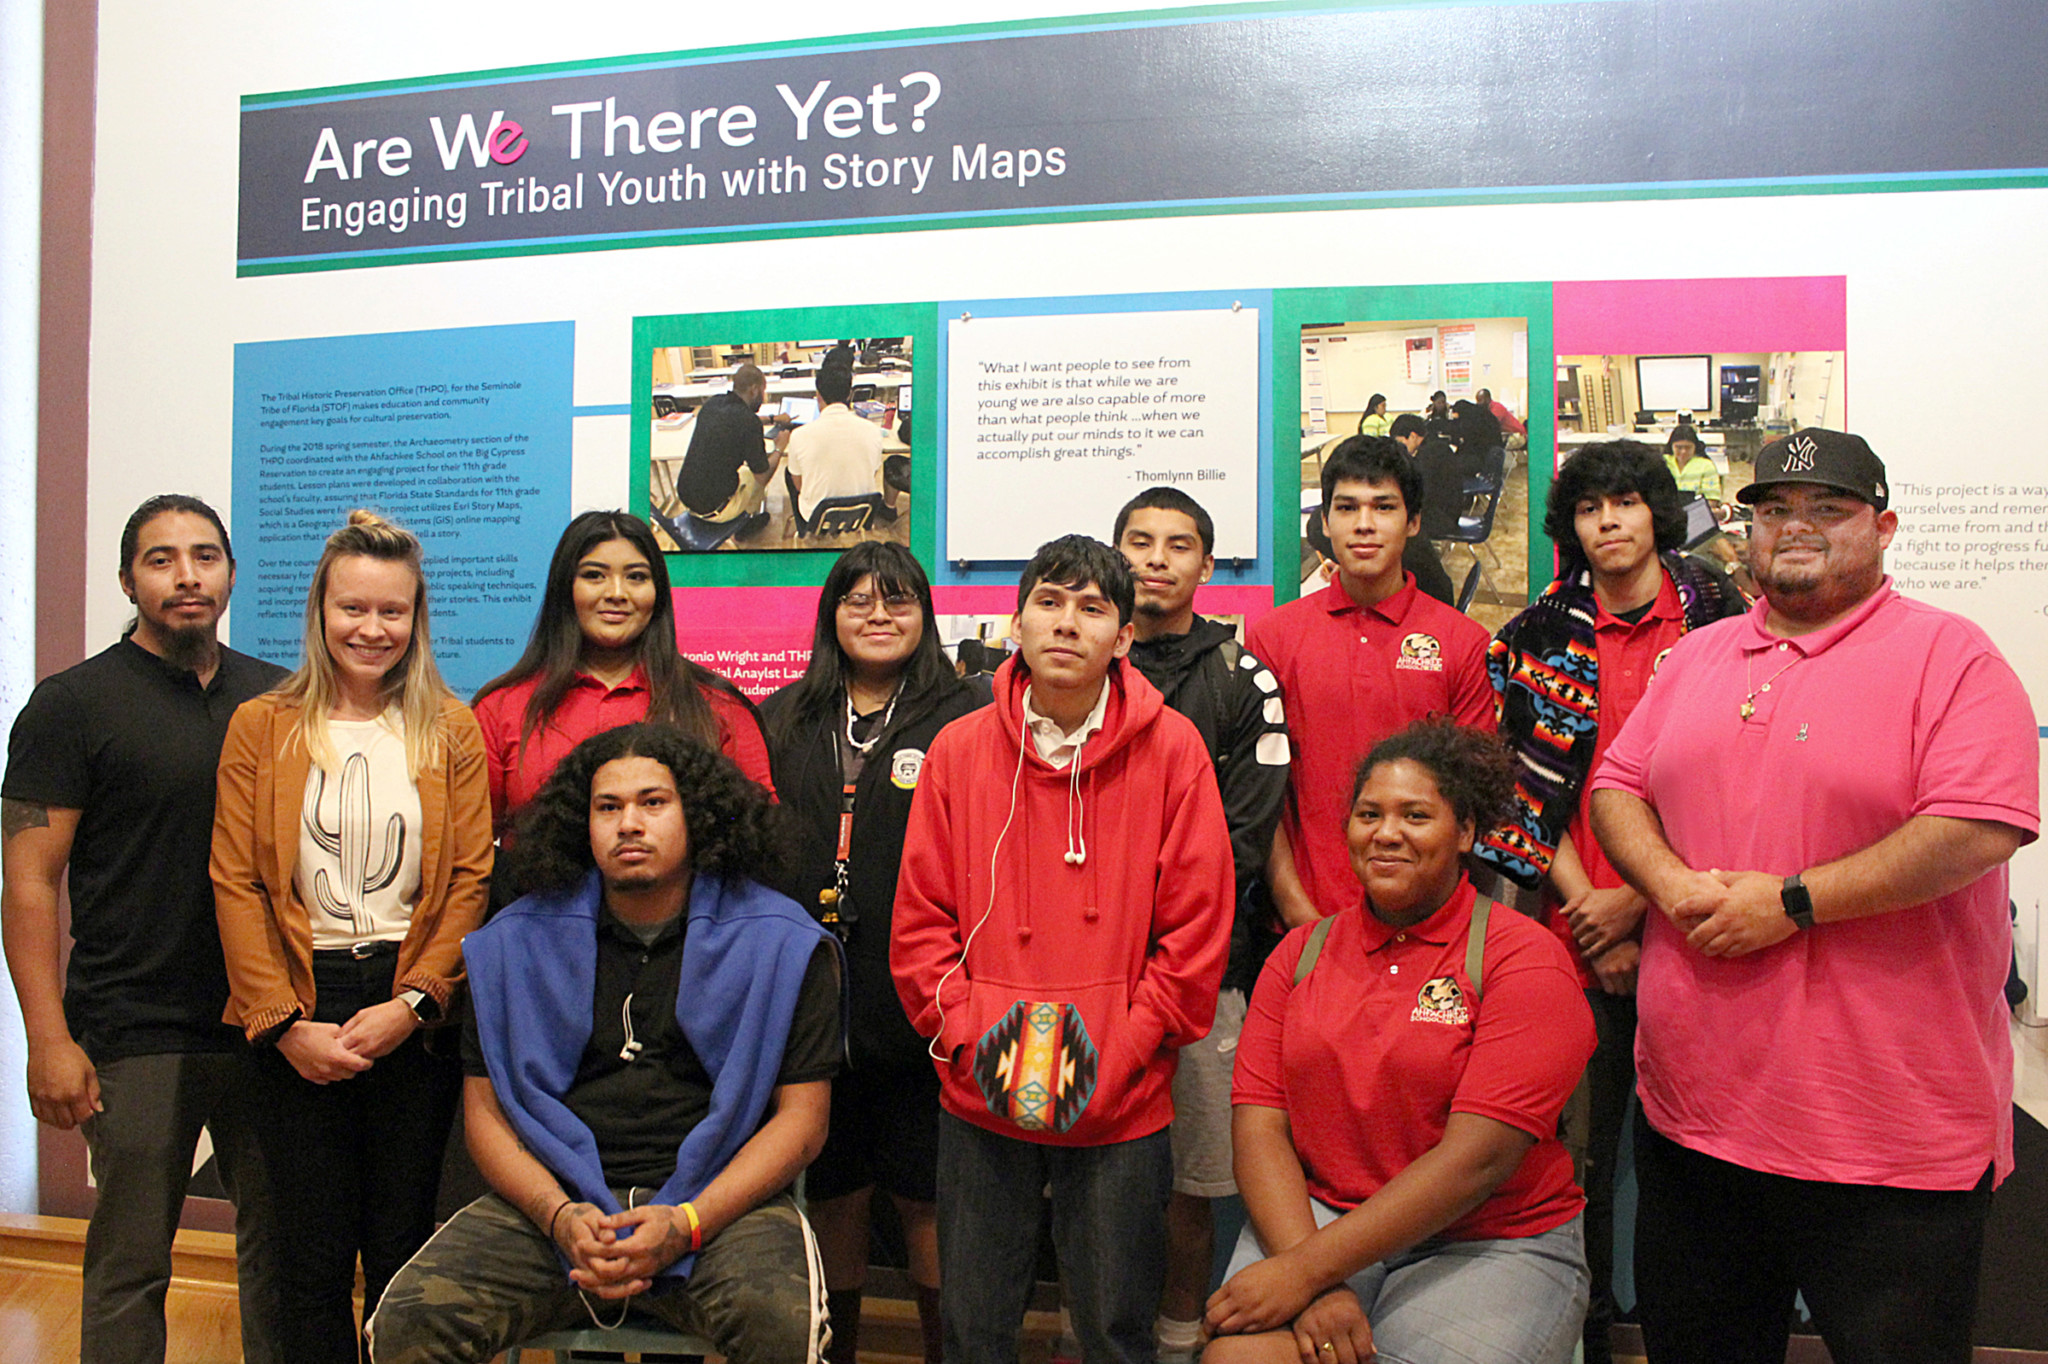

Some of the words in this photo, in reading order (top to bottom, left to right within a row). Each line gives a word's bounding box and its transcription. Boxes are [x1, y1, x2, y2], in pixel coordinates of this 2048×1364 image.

[304, 127, 412, 183] Are
[430, 110, 529, 164] We
[551, 96, 758, 158] There
[775, 70, 942, 140] Yet?
[301, 187, 468, 236] Engaging
[480, 173, 583, 216] Tribal
[598, 163, 707, 206] Youth
[722, 155, 806, 197] with
[822, 152, 934, 194] Story
[950, 142, 1066, 187] Maps
[1023, 361, 1026, 372] I
[1030, 362, 1062, 372] want
[1065, 358, 1110, 374] people
[1114, 359, 1128, 370] to
[1132, 360, 1154, 369] see
[1158, 355, 1190, 368] from
[978, 379, 1001, 390] this
[1005, 377, 1047, 390] exhibit
[1051, 378, 1061, 389] is
[1065, 376, 1091, 388] that
[1096, 375, 1130, 387] while
[1134, 377, 1152, 387] we
[1156, 377, 1178, 386] are
[278, 392, 299, 401] Tribal
[301, 390, 332, 399] Historic
[334, 387, 386, 398] Preservation
[388, 385, 413, 395] Office
[415, 384, 448, 395] (THPO),
[481, 380, 521, 390] Seminole
[260, 405, 280, 414] Tribe
[291, 403, 320, 413] Florida
[321, 401, 350, 414] (STOF)
[352, 401, 378, 410] makes
[380, 398, 422, 408] education
[441, 396, 489, 407] community
[978, 397, 1017, 410] young
[1020, 398, 1038, 406] we
[1042, 397, 1063, 406] are
[1066, 393, 1093, 405] also
[1097, 392, 1149, 408] capable
[1153, 391, 1167, 403] of
[1170, 394, 1205, 403] more
[259, 418, 309, 429] engagement
[326, 414, 348, 426] goals
[363, 413, 394, 422] cultural
[397, 411, 450, 422] preservation.
[978, 411, 1006, 424] than
[1010, 411, 1042, 424] what
[1045, 411, 1090, 426] people
[1094, 409, 1127, 422] think
[1132, 408, 1177, 421] ...when
[1181, 412, 1200, 420] we
[977, 429, 1028, 445] actually
[1031, 431, 1053, 444] put
[1057, 431, 1079, 440] our
[1082, 427, 1123, 440] minds
[1127, 429, 1141, 439] to
[1145, 427, 1153, 438] it
[1157, 429, 1176, 438] we
[1179, 429, 1203, 438] can
[260, 444, 286, 454] During
[302, 441, 324, 451] 2018
[325, 441, 350, 452] spring
[351, 440, 392, 449] semester,
[409, 436, 468, 447] Archaeometry
[471, 435, 501, 444] section
[260, 457, 284, 465] THPO
[286, 455, 333, 464] coordinated
[370, 451, 413, 461] Ahfachkee
[416, 450, 444, 459] School
[491, 447, 525, 459] Cypress
[977, 446, 1050, 462] accomplish
[1053, 447, 1087, 461] great
[260, 467, 306, 478] Reservation
[318, 468, 344, 476] create
[357, 465, 394, 477] engaging
[396, 465, 424, 475] project
[440, 463, 460, 471] their
[482, 461, 506, 472] grade
[1135, 469, 1193, 484] Thomlynn
[1197, 468, 1225, 480] Billie
[259, 481, 296, 490] students.
[298, 480, 326, 489] Lesson
[328, 479, 350, 490] plans
[373, 477, 416, 488] developed
[427, 475, 482, 485] collaboration
[259, 493, 290, 503] school's
[292, 492, 322, 504] faculty,
[323, 491, 358, 503] assuring
[378, 490, 408, 500] Florida
[410, 489, 432, 499] State
[434, 488, 478, 498] Standards
[515, 486, 540, 498] grade
[1936, 483, 1988, 499] project
[1993, 483, 2004, 495] is
[2008, 486, 2017, 495] a
[259, 507, 282, 516] Social
[284, 506, 314, 516] Studies
[390, 504, 419, 514] project
[421, 502, 451, 511] utilizes
[471, 501, 494, 512] Story
[1894, 501, 1965, 514] ourselves
[1969, 501, 1998, 514] and
[258, 520, 281, 529] which
[298, 518, 344, 530] Geographic
[394, 516, 431, 527] Systems
[455, 515, 481, 524] online
[483, 514, 520, 525] mapping
[1919, 524, 1960, 533] came
[1964, 520, 2000, 533] from
[2004, 520, 2033, 533] and
[258, 533, 301, 543] application
[438, 530, 460, 539] story.
[1894, 542, 1901, 551] a
[1907, 538, 1939, 555] fight
[1944, 541, 1960, 552] to
[1964, 542, 2029, 555] progress
[451, 554, 493, 566] important
[496, 554, 518, 563] skills
[1894, 558, 1955, 570] because
[1960, 558, 1969, 570] it
[1974, 558, 2014, 574] helps
[257, 573, 296, 581] necessary
[437, 568, 473, 579] projects,
[475, 567, 514, 579] including
[257, 584, 293, 595] acquiring
[447, 581, 485, 592] speaking
[487, 580, 536, 591] techniques,
[1894, 576, 1925, 589] who
[1929, 580, 1950, 589] we
[426, 594, 447, 603] their
[449, 594, 480, 603] stories.
[502, 594, 531, 603] exhibit
[257, 609, 287, 618] reflects
[439, 636, 463, 645] Tribal
[465, 636, 503, 645] students
[258, 650, 279, 658] share
[281, 650, 298, 659] their
[716, 650, 759, 665] Wright
[761, 650, 785, 661] and
[733, 664, 780, 681] Anaylst
